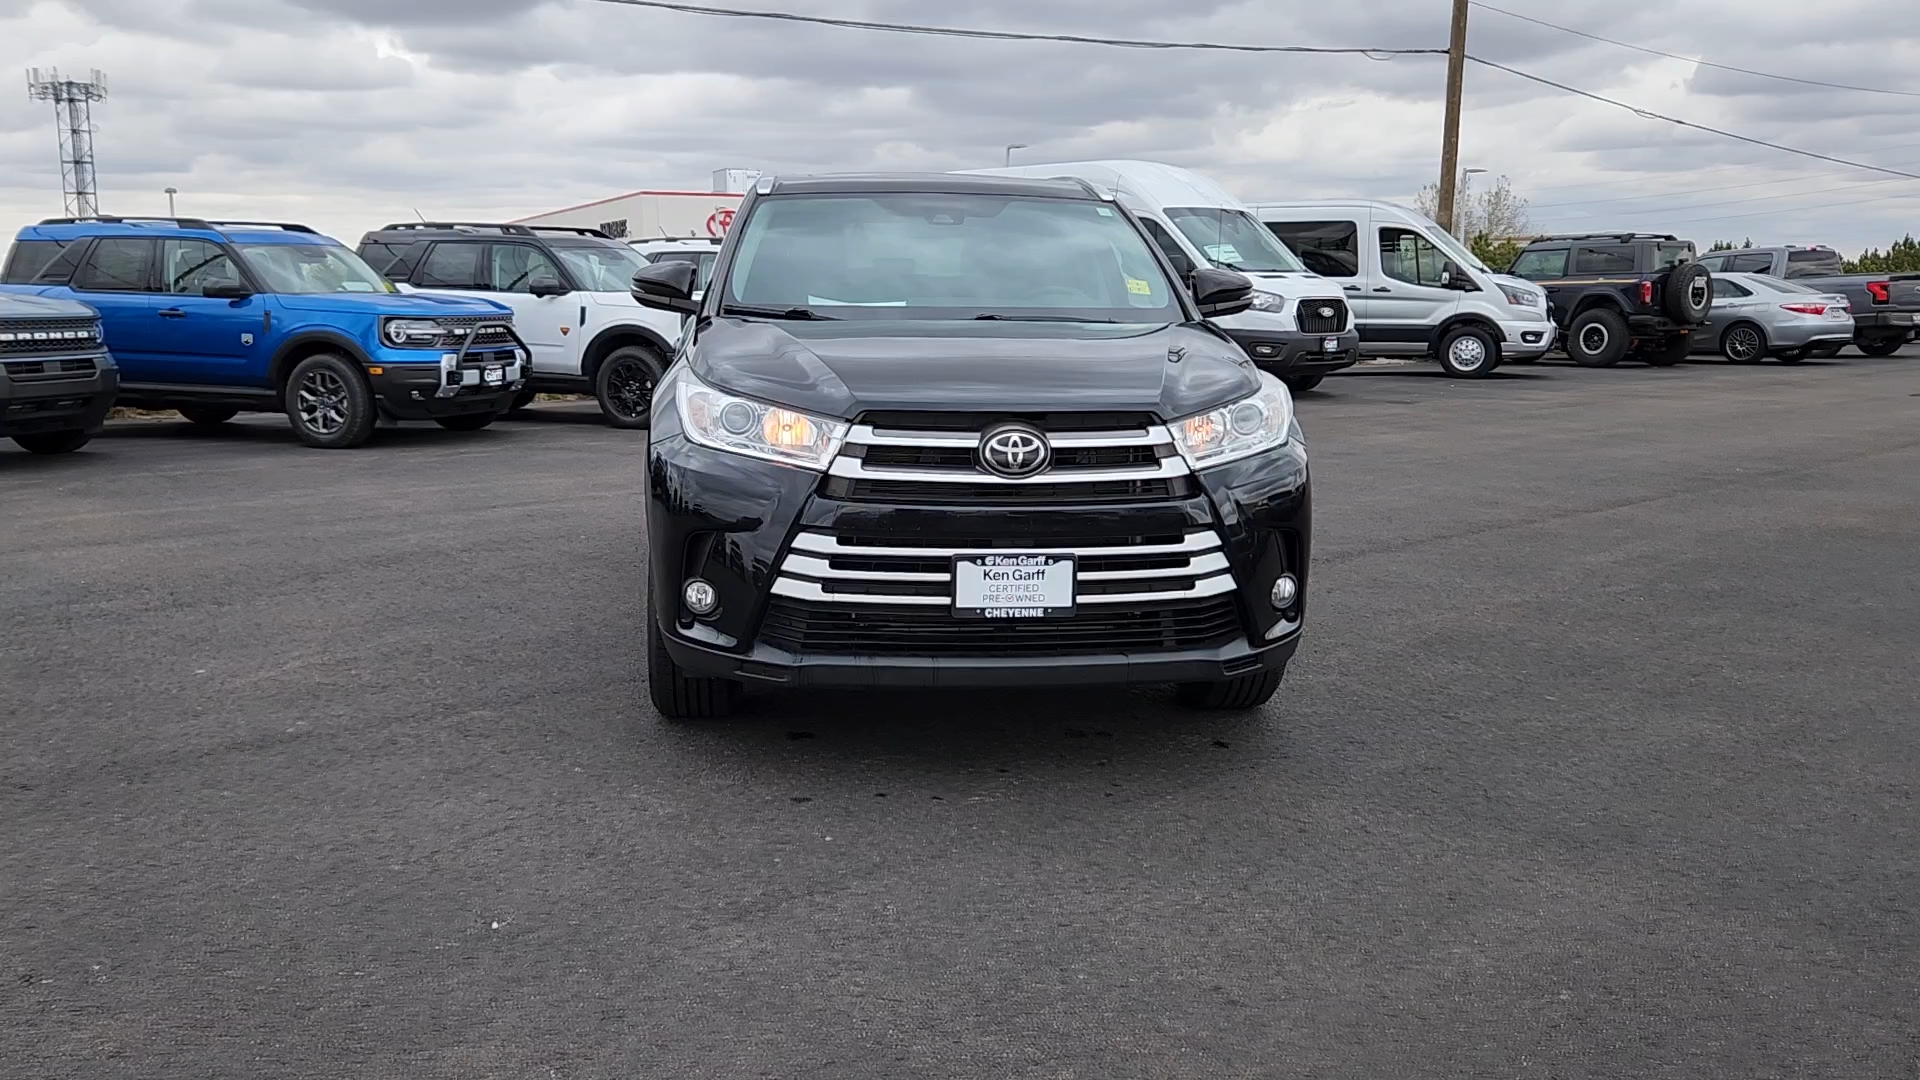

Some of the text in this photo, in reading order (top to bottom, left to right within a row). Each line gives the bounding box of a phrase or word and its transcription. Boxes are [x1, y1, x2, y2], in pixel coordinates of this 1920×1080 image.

[995, 555, 1017, 566] Ken
[1018, 555, 1047, 566] Garff
[983, 568, 1046, 581] Ken Garff
[988, 584, 1040, 593] CERTIFIED
[984, 608, 1045, 618] CHEYENNE
